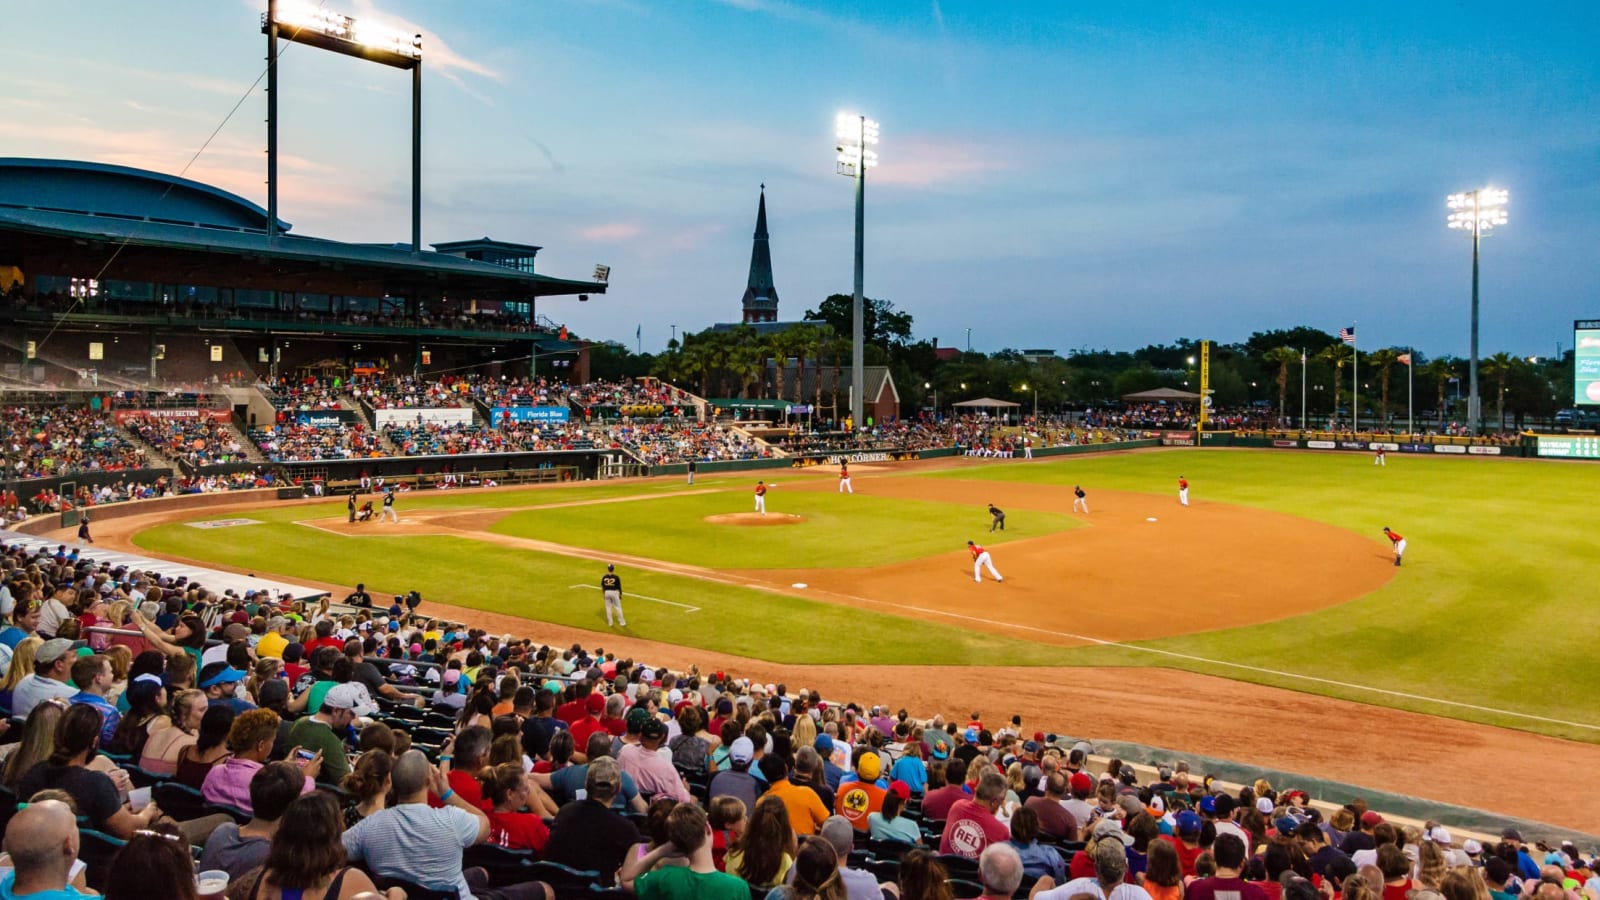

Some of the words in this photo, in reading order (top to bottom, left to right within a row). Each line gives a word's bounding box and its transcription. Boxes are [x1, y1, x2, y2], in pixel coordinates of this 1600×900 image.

[310, 416, 339, 424] bestbet
[851, 452, 886, 463] CORNER
[603, 578, 616, 586] 32
[352, 595, 364, 604] 34
[956, 828, 978, 849] REL
